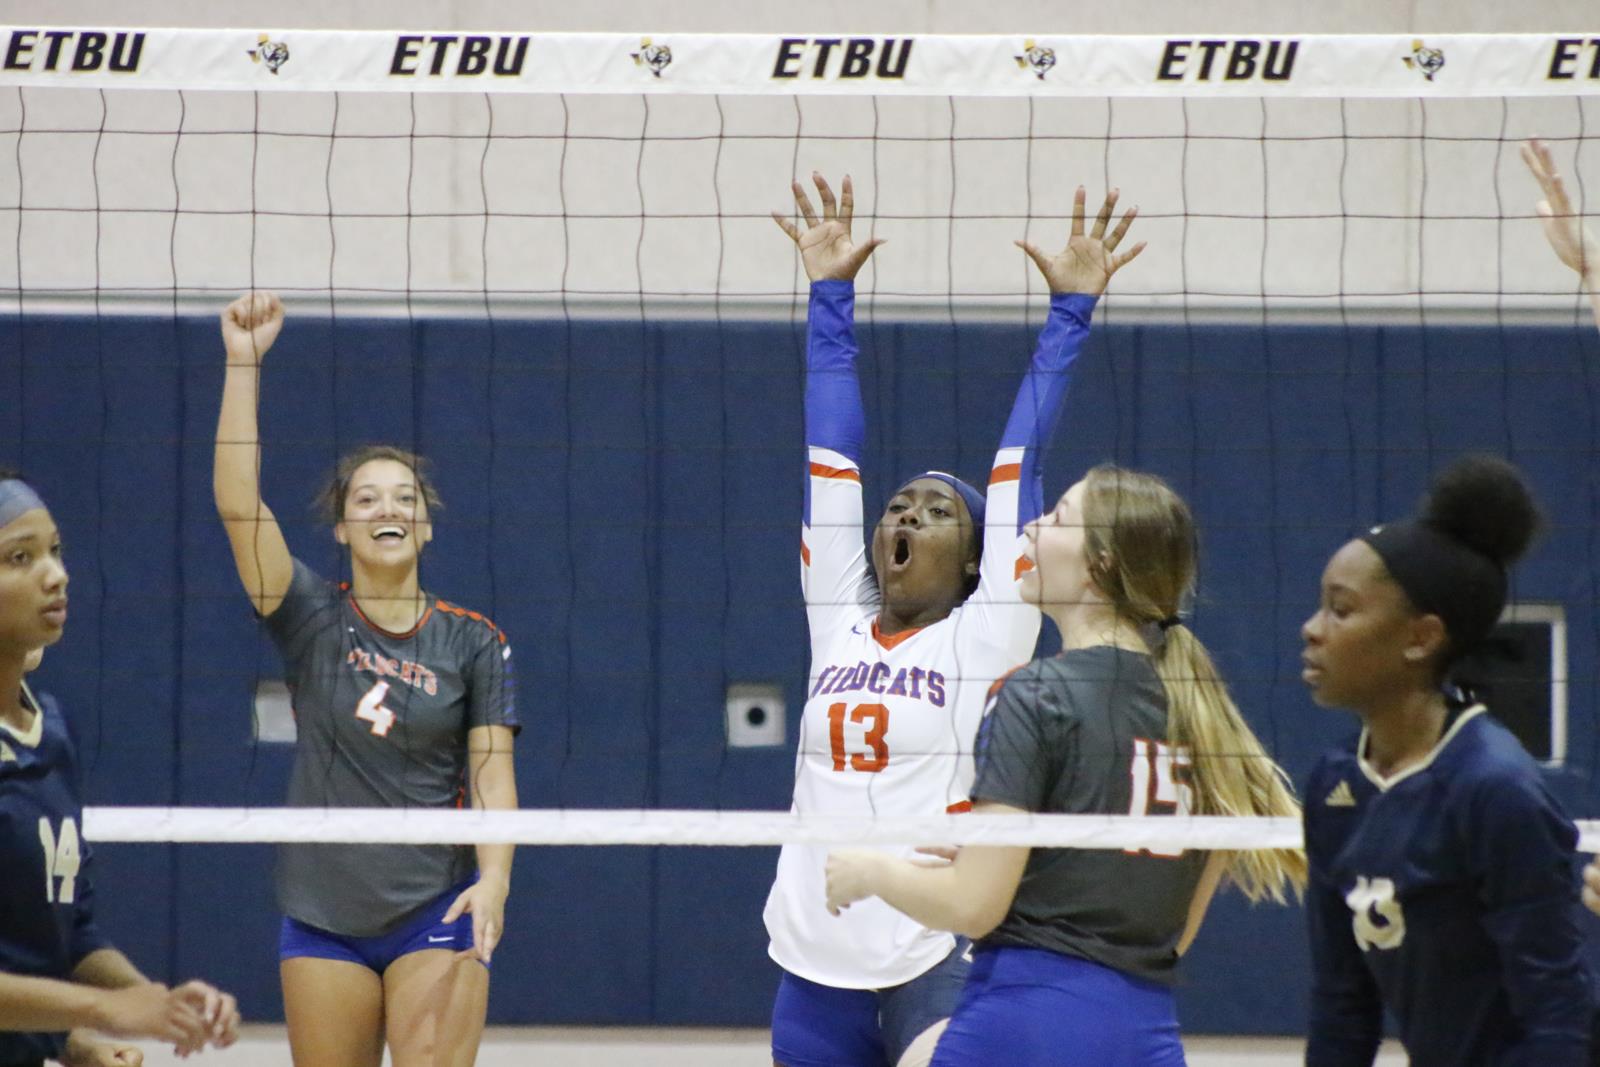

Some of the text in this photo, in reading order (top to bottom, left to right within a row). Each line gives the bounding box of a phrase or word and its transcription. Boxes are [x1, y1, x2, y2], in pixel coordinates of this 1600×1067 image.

[3, 30, 146, 73] ETBU
[388, 36, 531, 76] ETBU
[771, 38, 915, 79] ETBU
[1156, 40, 1300, 81] ETBU
[355, 680, 397, 738] 4
[827, 702, 890, 773] 13
[38, 816, 81, 904] 14
